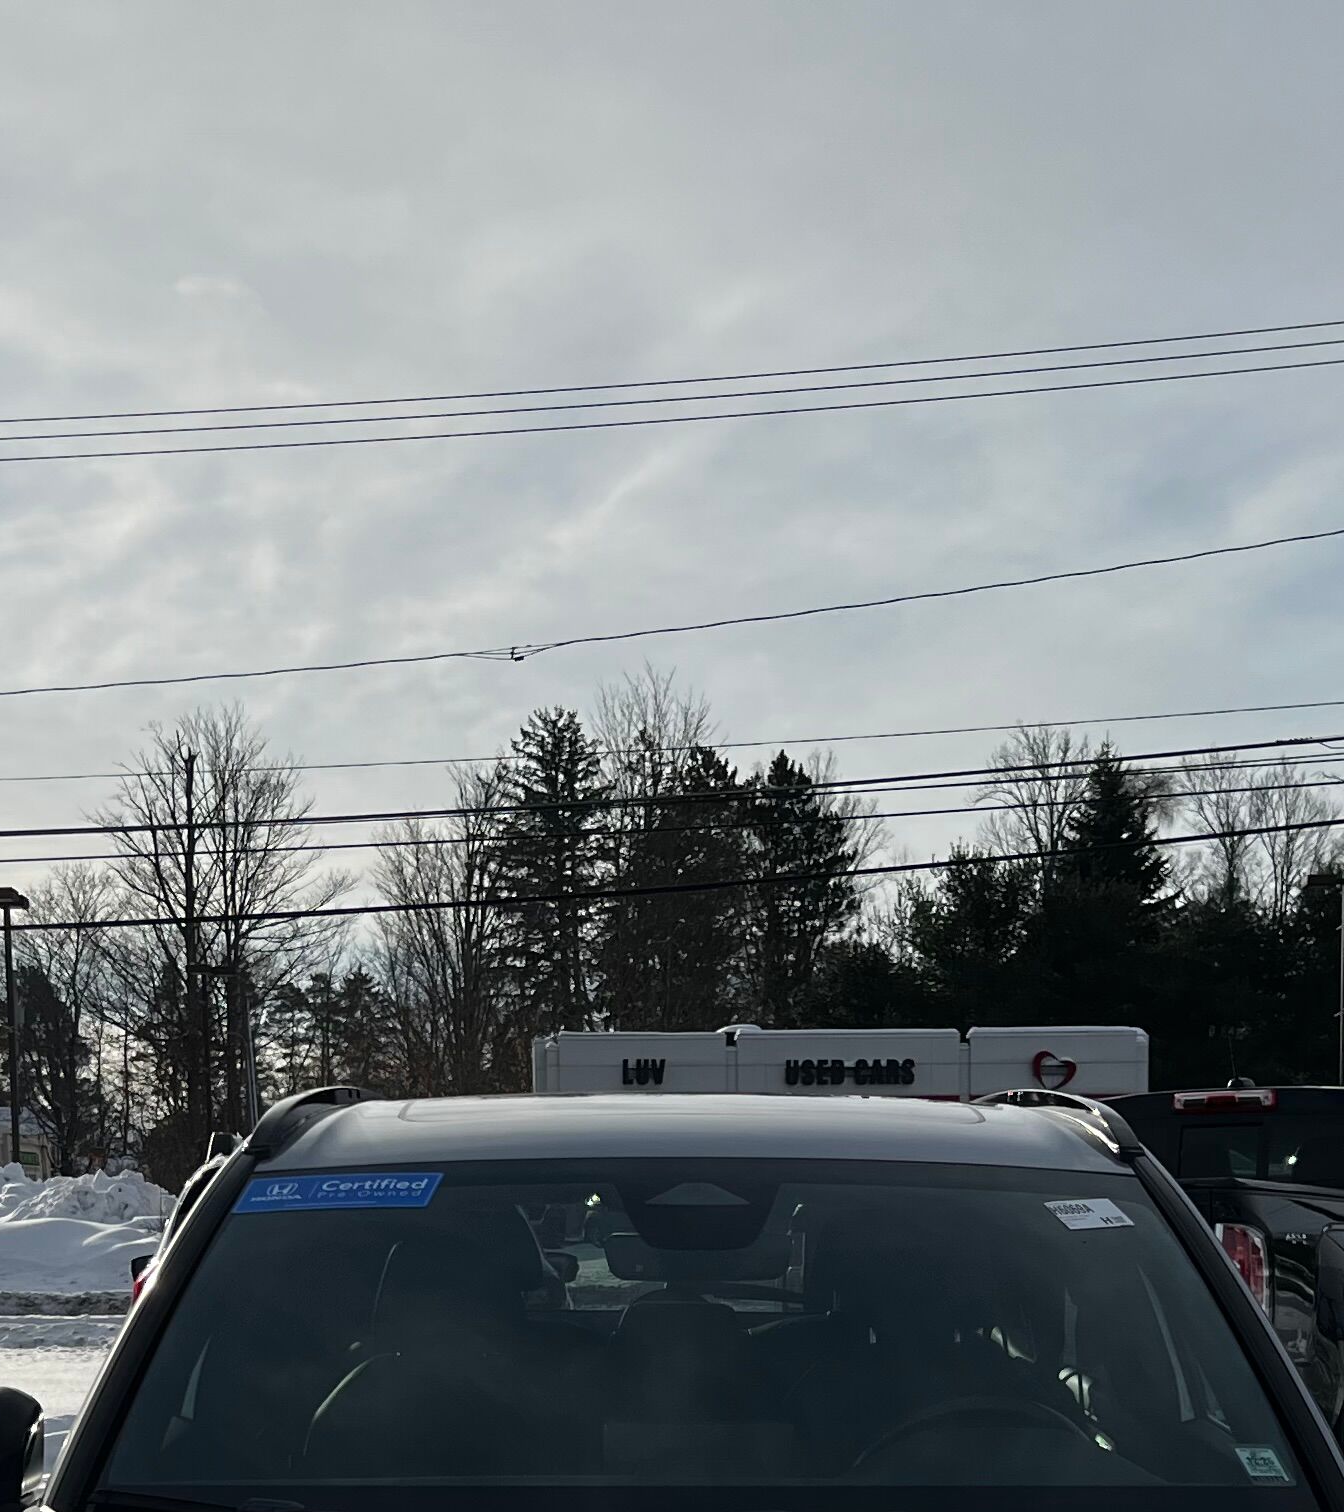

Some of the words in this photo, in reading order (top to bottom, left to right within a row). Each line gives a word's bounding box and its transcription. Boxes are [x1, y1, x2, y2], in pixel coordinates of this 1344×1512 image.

[622, 1059, 666, 1085] LUV
[785, 1059, 845, 1085] USED
[854, 1059, 915, 1085] CARS
[321, 1178, 428, 1190] Certified
[249, 1194, 302, 1202] HONDA
